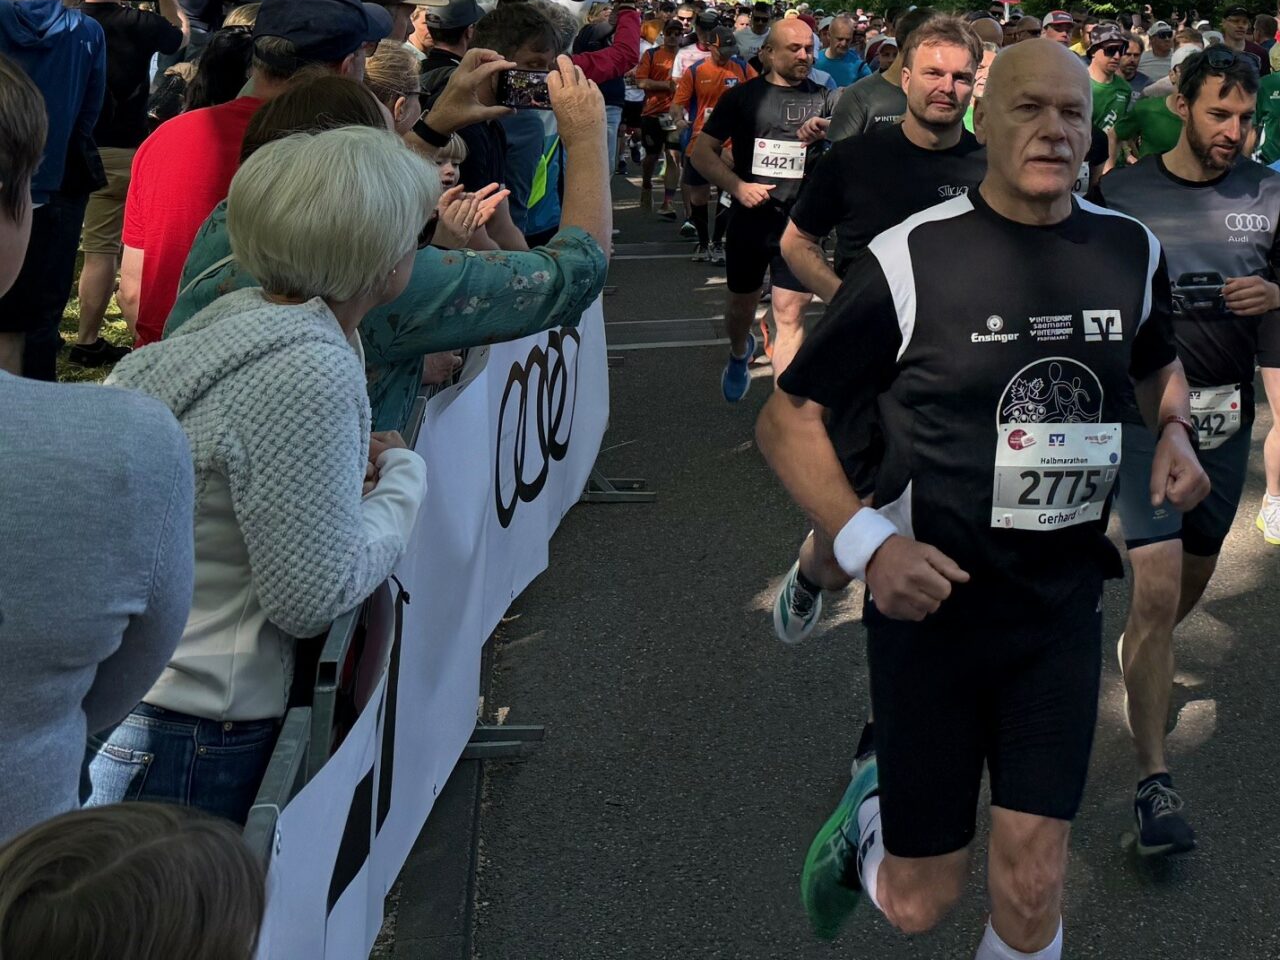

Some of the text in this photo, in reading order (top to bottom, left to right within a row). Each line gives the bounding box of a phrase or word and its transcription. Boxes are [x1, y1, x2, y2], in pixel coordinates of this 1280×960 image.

[761, 155, 796, 170] 4421
[1227, 235, 1249, 243] Audi
[970, 332, 1020, 344] Ensinger
[1040, 457, 1089, 465] Halbmarathon
[1018, 470, 1101, 506] 2775
[1038, 511, 1078, 525] Gerhard
